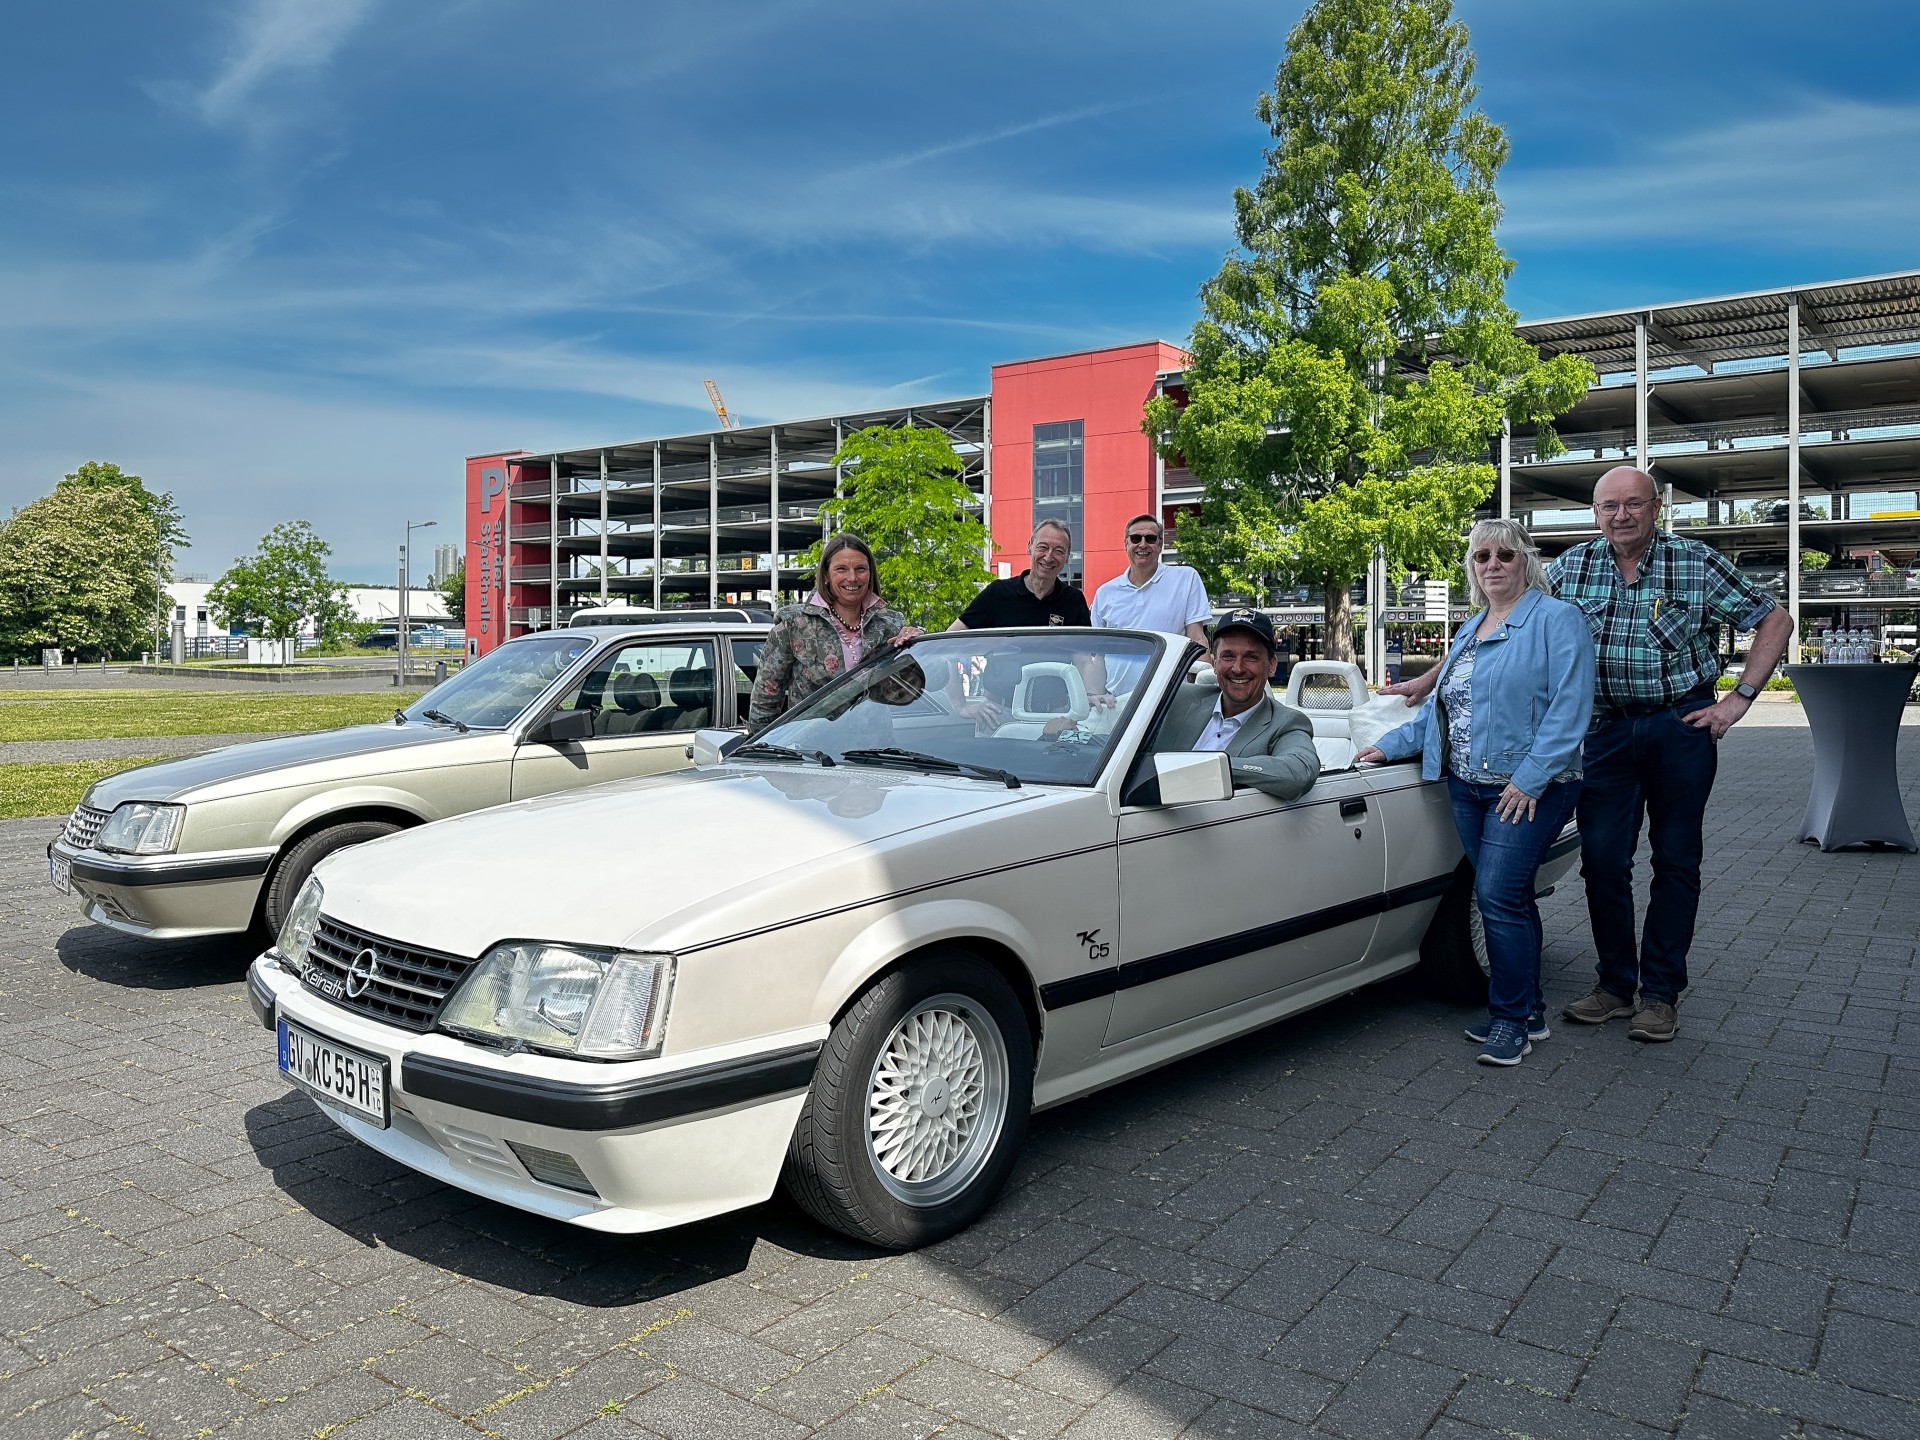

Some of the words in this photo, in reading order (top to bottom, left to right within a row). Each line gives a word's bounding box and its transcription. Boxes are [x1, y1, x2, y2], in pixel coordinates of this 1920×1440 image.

[481, 466, 505, 513] P
[493, 519, 503, 547] an
[480, 521, 491, 634] Stadthalle
[493, 552, 504, 589] der
[1089, 942, 1110, 960] C5
[301, 961, 346, 999] Keinath
[288, 1030, 304, 1074] GV
